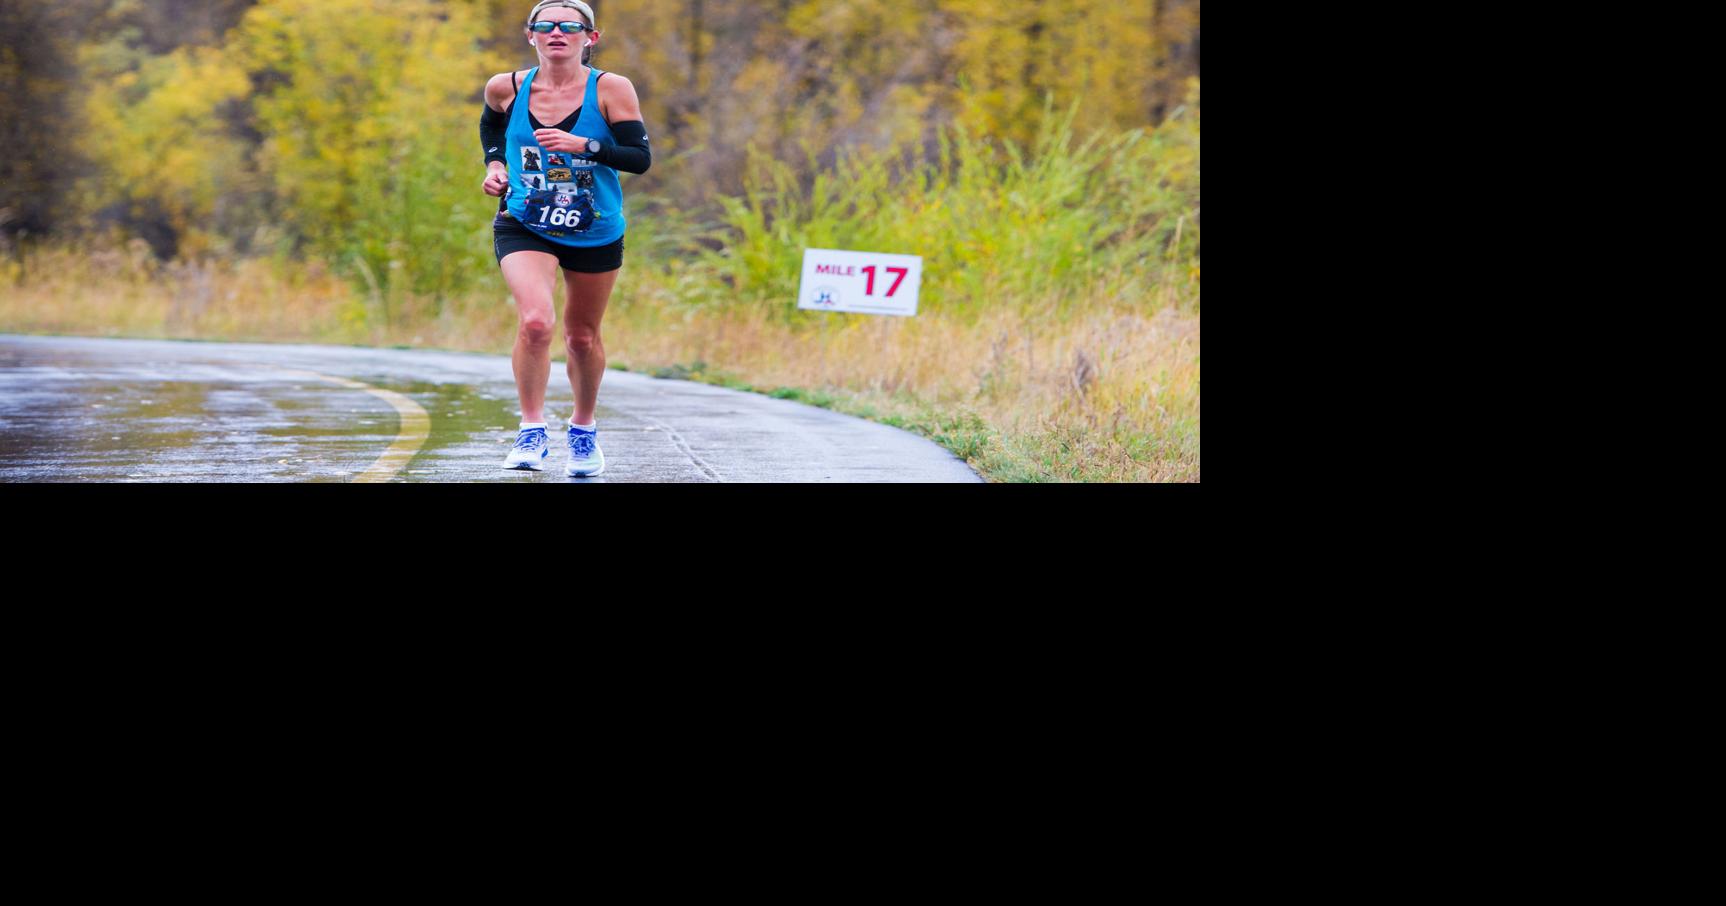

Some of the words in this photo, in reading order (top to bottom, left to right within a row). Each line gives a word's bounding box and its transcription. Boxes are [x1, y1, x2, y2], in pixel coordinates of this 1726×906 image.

[539, 205, 581, 228] 166
[816, 264, 855, 277] MILE
[861, 265, 909, 298] 17
